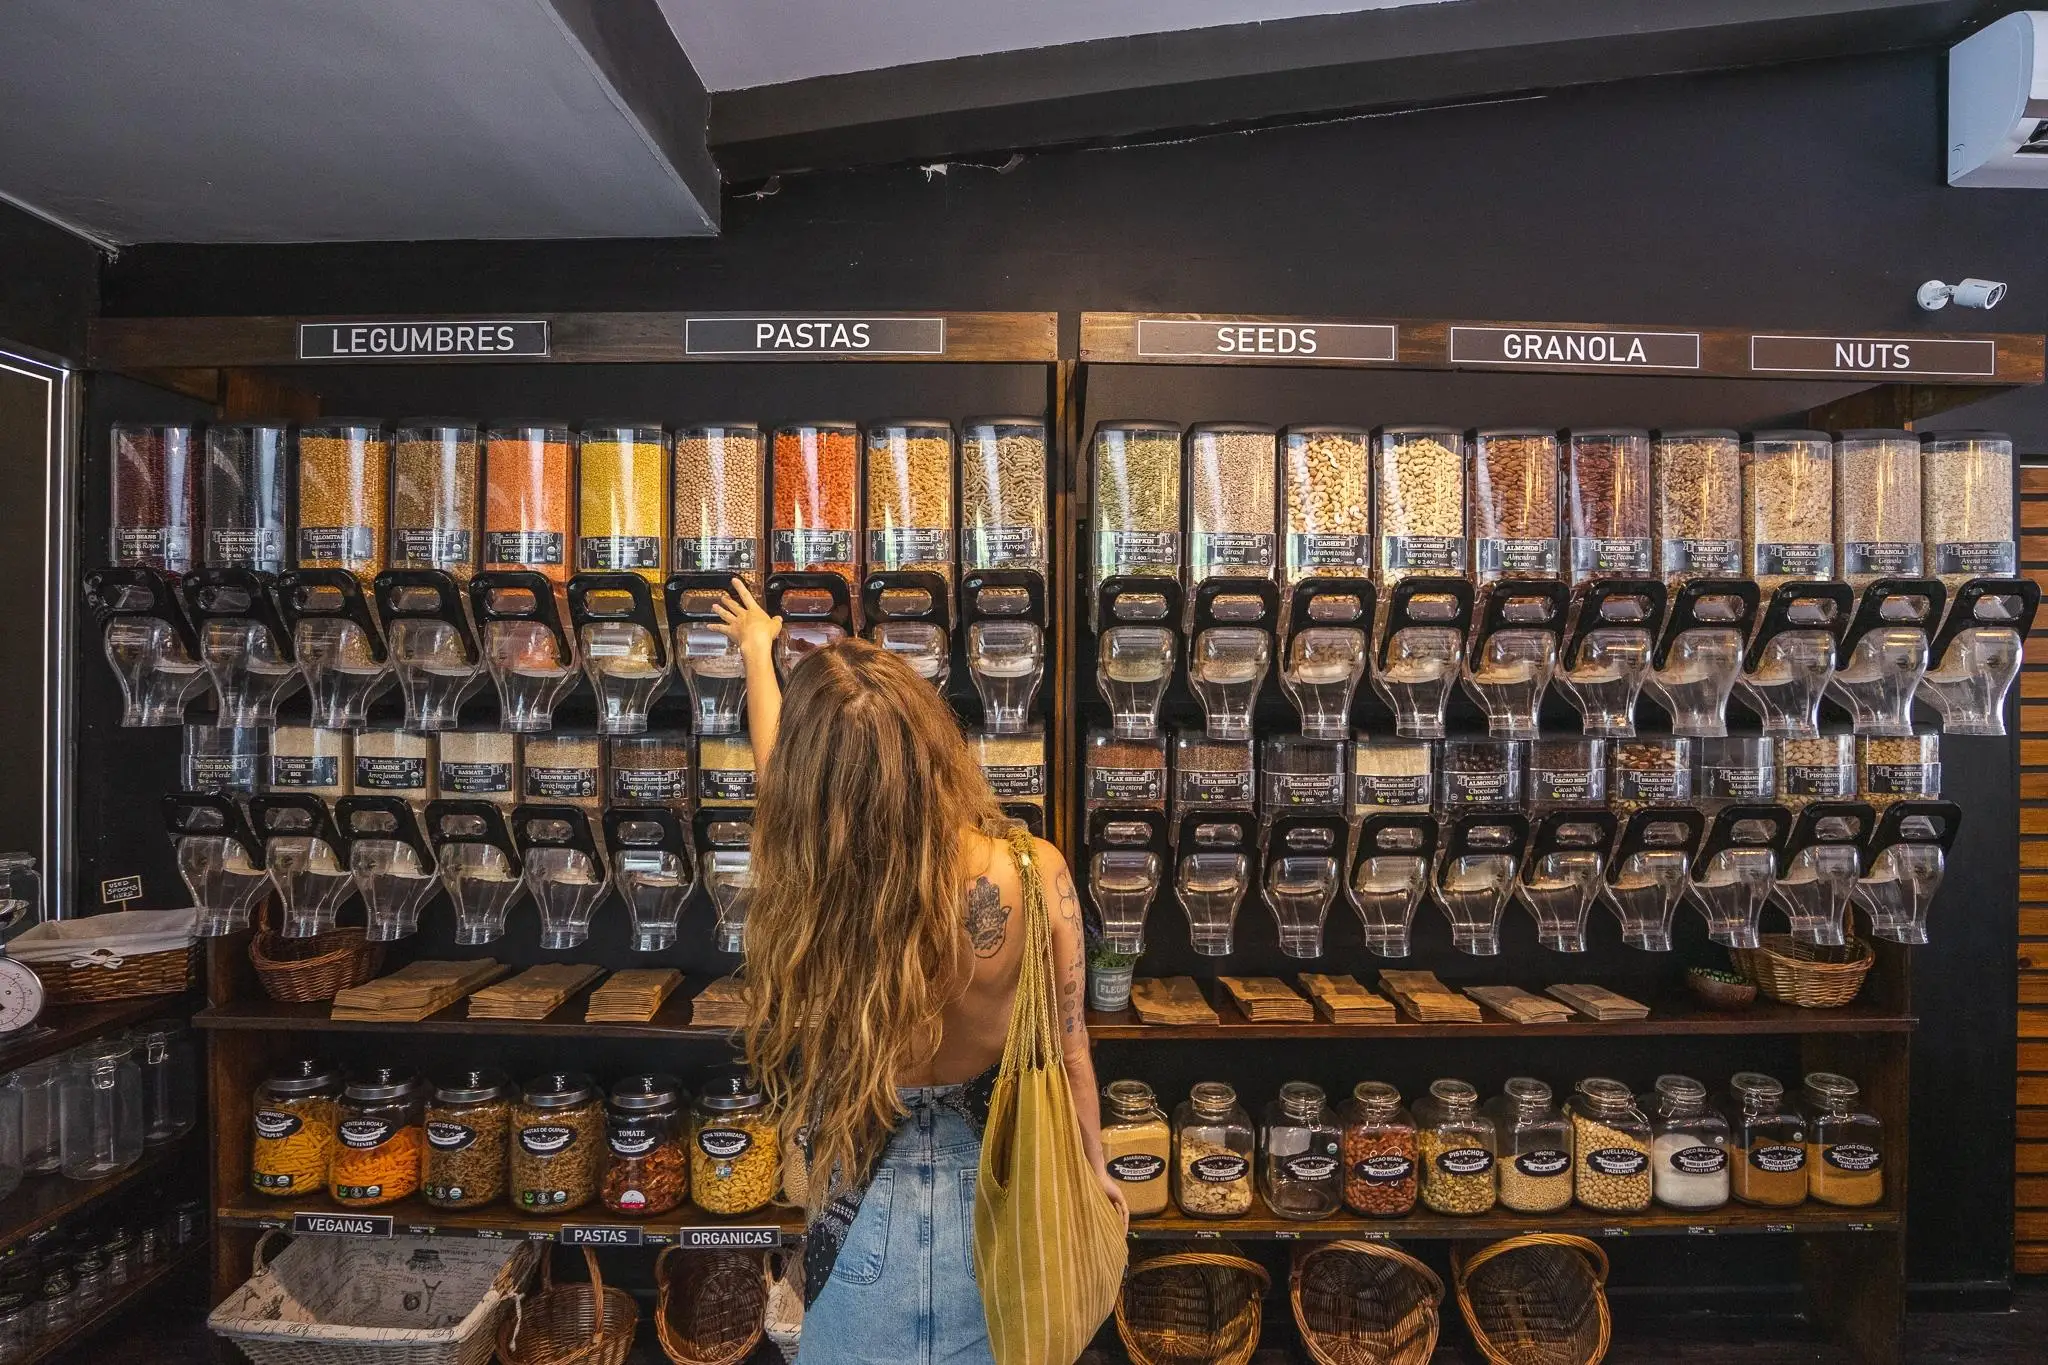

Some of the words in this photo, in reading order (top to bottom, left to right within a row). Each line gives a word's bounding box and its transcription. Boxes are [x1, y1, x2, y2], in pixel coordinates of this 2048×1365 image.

[332, 326, 515, 352] LEGUMBRES
[756, 322, 871, 348] PASTAS
[1216, 328, 1318, 354] SEEDS
[1503, 334, 1648, 362] GRANOLA
[1834, 342, 1911, 370] NUTS
[1222, 547, 1245, 556] Girasol
[106, 885, 138, 896] SPOONS
[1100, 983, 1129, 994] FLEURS
[1448, 1150, 1485, 1159] PISTACHOS
[1602, 1149, 1638, 1157] AVELLANAS
[1682, 1148, 1697, 1156] COCO
[1760, 1146, 1780, 1154] AZUCAR
[1787, 1146, 1802, 1154] COCO
[307, 1218, 374, 1234] VEGANAS
[574, 1230, 628, 1244] PASTAS
[691, 1232, 773, 1245] ORGANICAS
